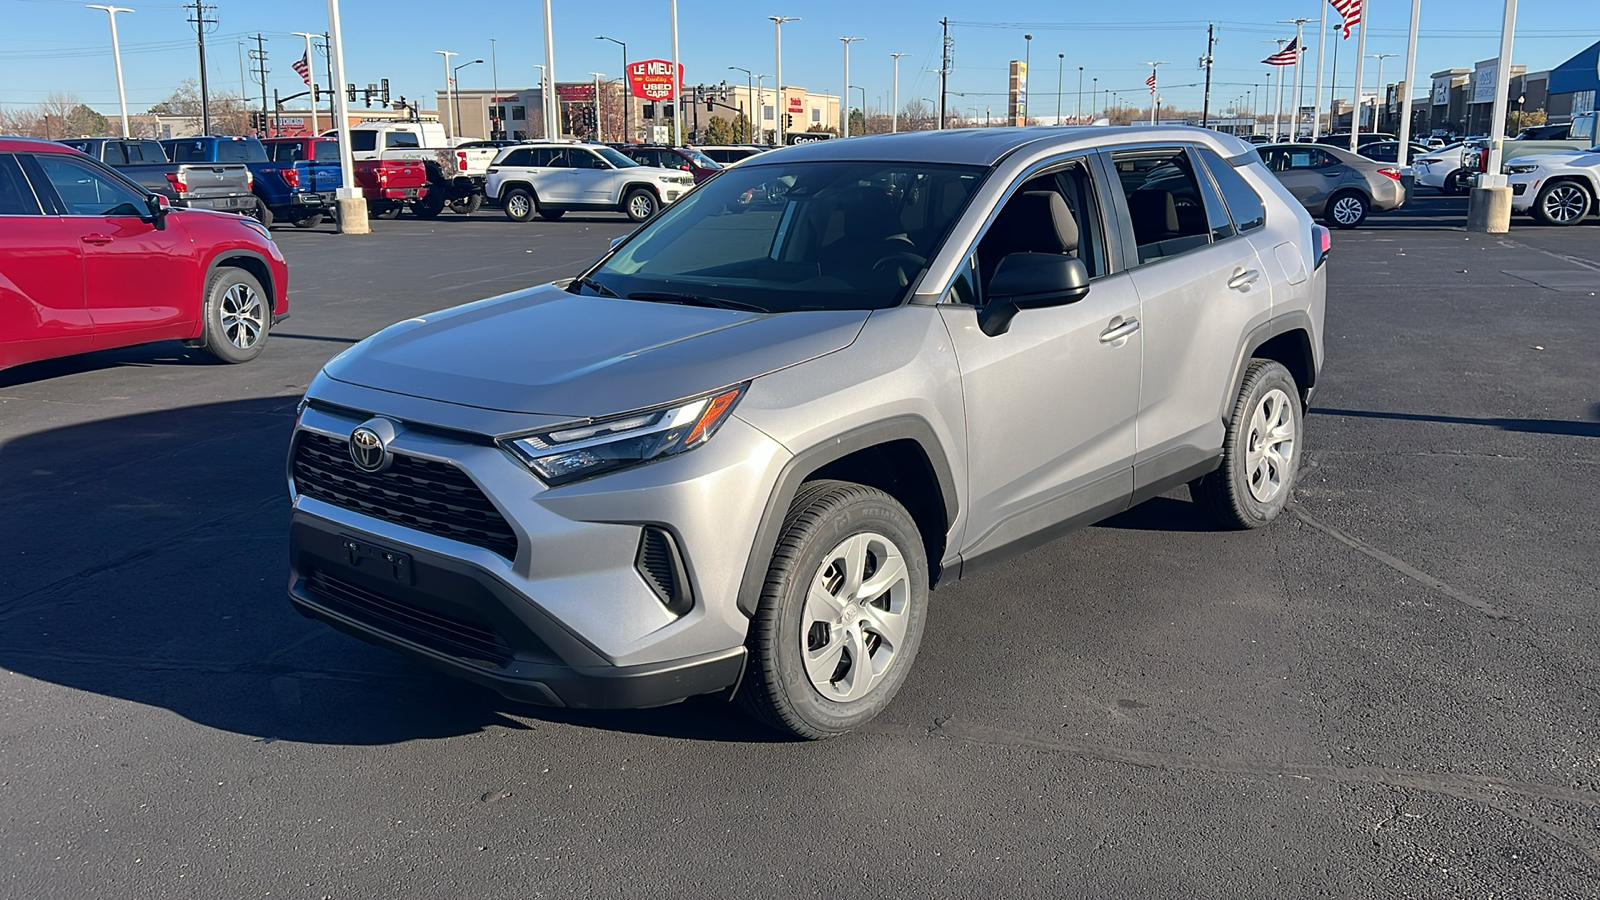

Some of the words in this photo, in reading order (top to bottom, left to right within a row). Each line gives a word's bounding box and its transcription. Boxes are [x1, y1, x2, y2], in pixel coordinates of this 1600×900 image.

[633, 64, 645, 75] LE
[642, 83, 672, 91] USED
[646, 90, 669, 98] CARS
